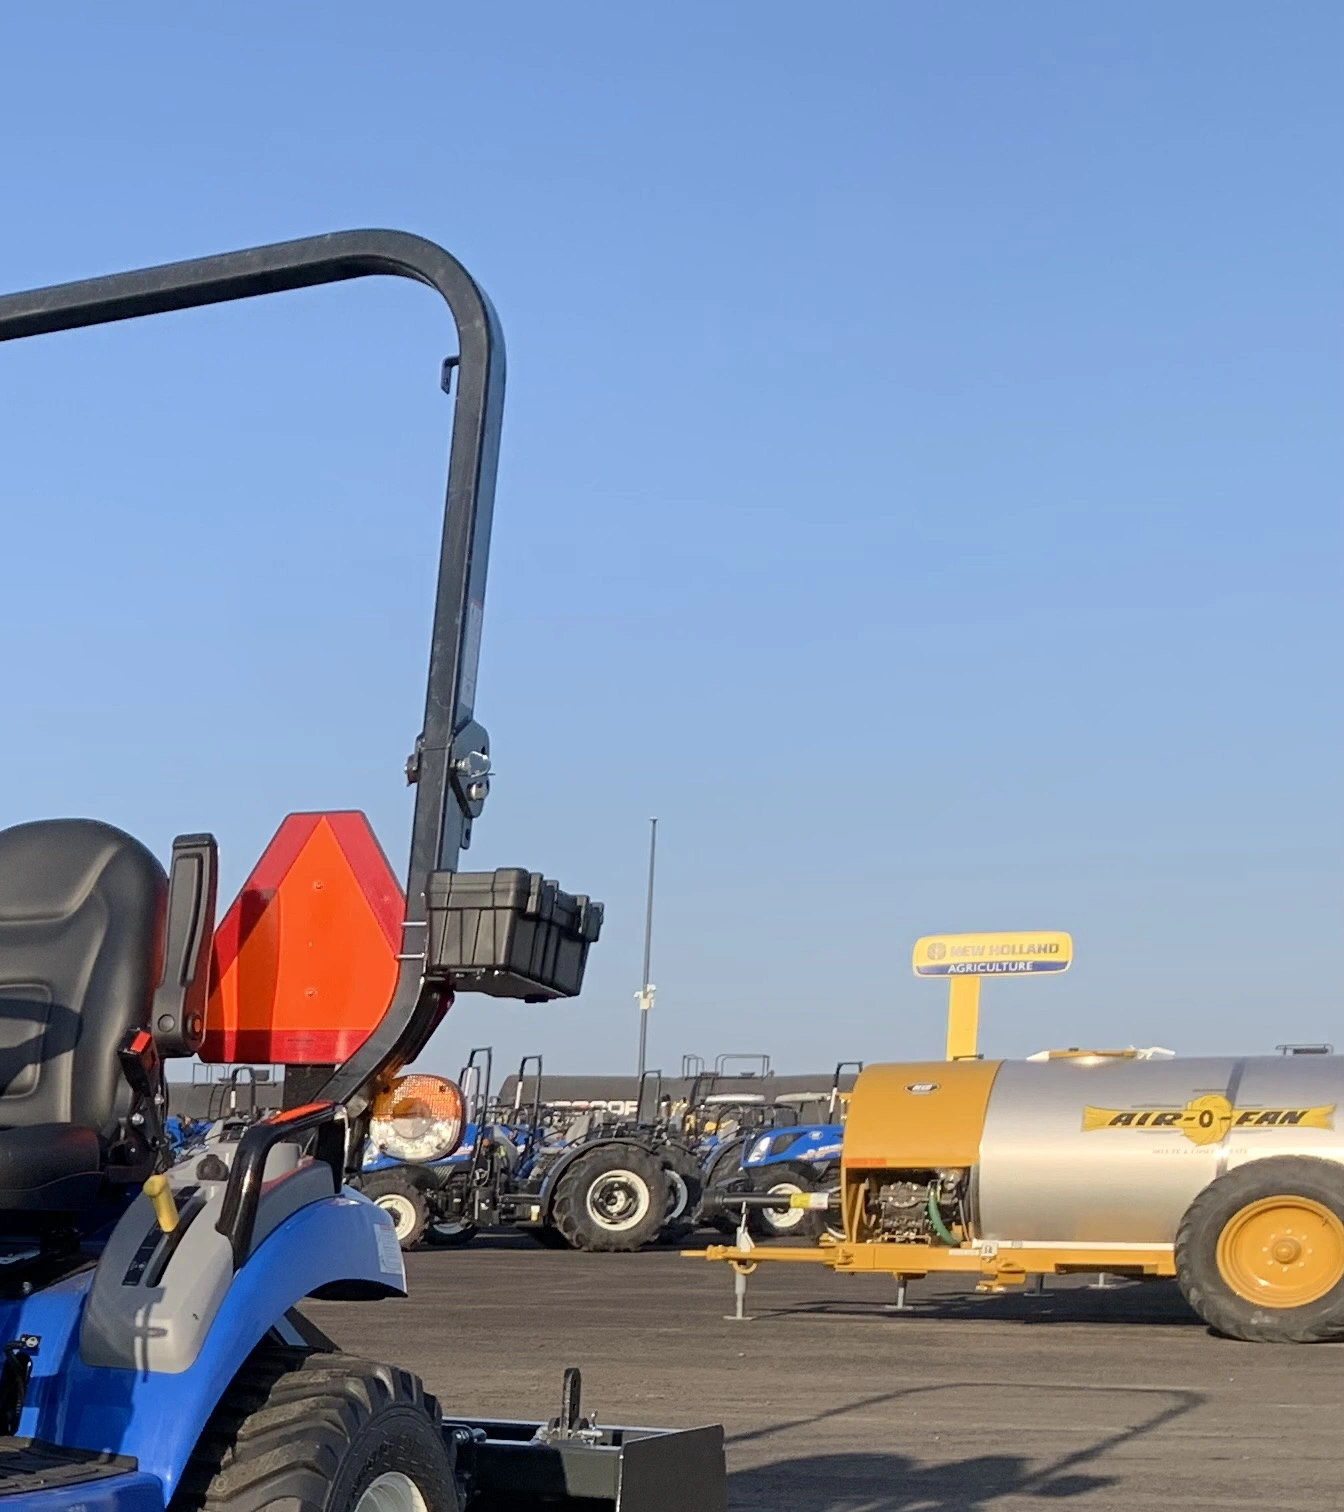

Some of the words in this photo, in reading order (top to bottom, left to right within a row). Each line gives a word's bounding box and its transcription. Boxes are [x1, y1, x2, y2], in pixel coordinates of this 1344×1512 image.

[950, 945, 986, 957] NEW
[989, 943, 1060, 956] HOLLAND
[947, 961, 1035, 974] AGRICULTURE
